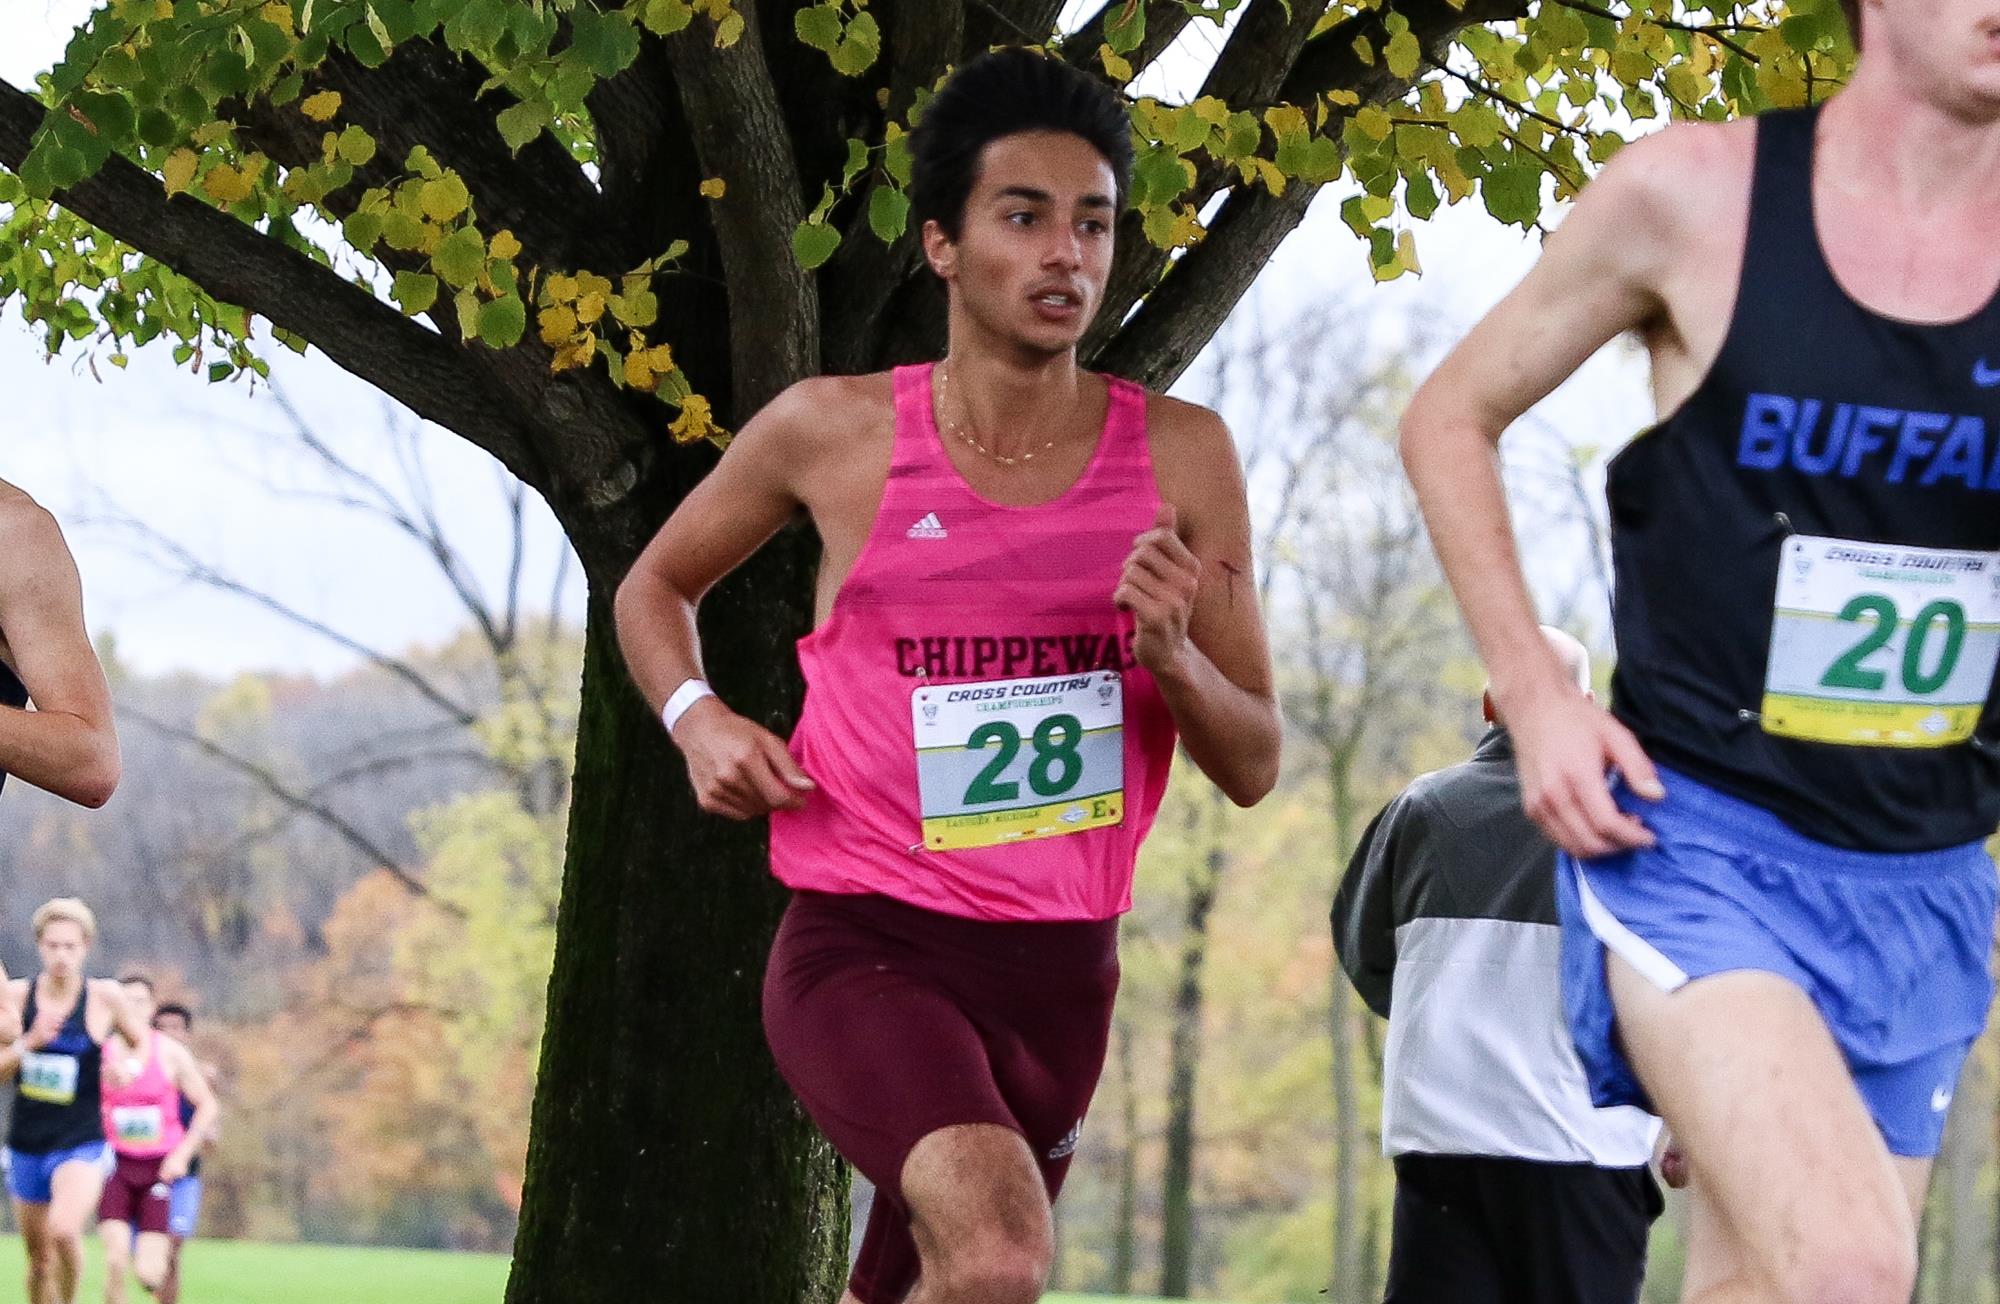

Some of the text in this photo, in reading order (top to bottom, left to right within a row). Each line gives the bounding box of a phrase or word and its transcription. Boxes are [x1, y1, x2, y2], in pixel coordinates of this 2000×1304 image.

[1736, 392, 2000, 490] BUFFA
[947, 677, 1091, 703] CROSS COUNTRY
[1820, 594, 1966, 694] 20
[963, 713, 1083, 805] 28
